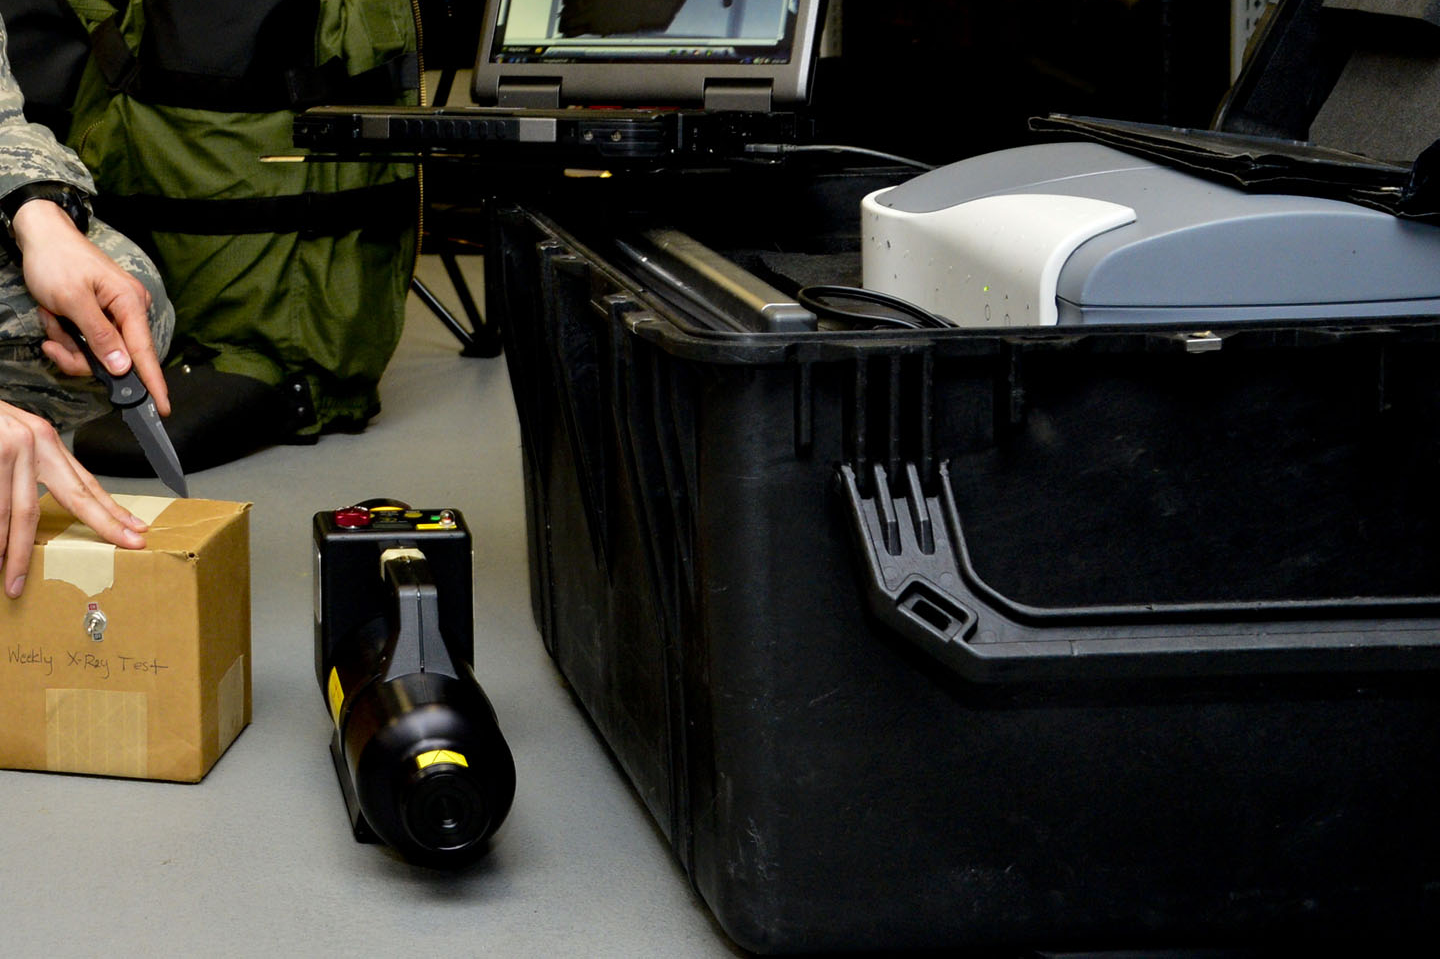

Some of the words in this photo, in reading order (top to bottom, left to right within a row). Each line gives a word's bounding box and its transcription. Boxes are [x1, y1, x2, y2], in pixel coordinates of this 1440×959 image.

[8, 643, 53, 676] Weekly
[67, 650, 110, 680] X-Ray
[117, 655, 169, 675] Test
